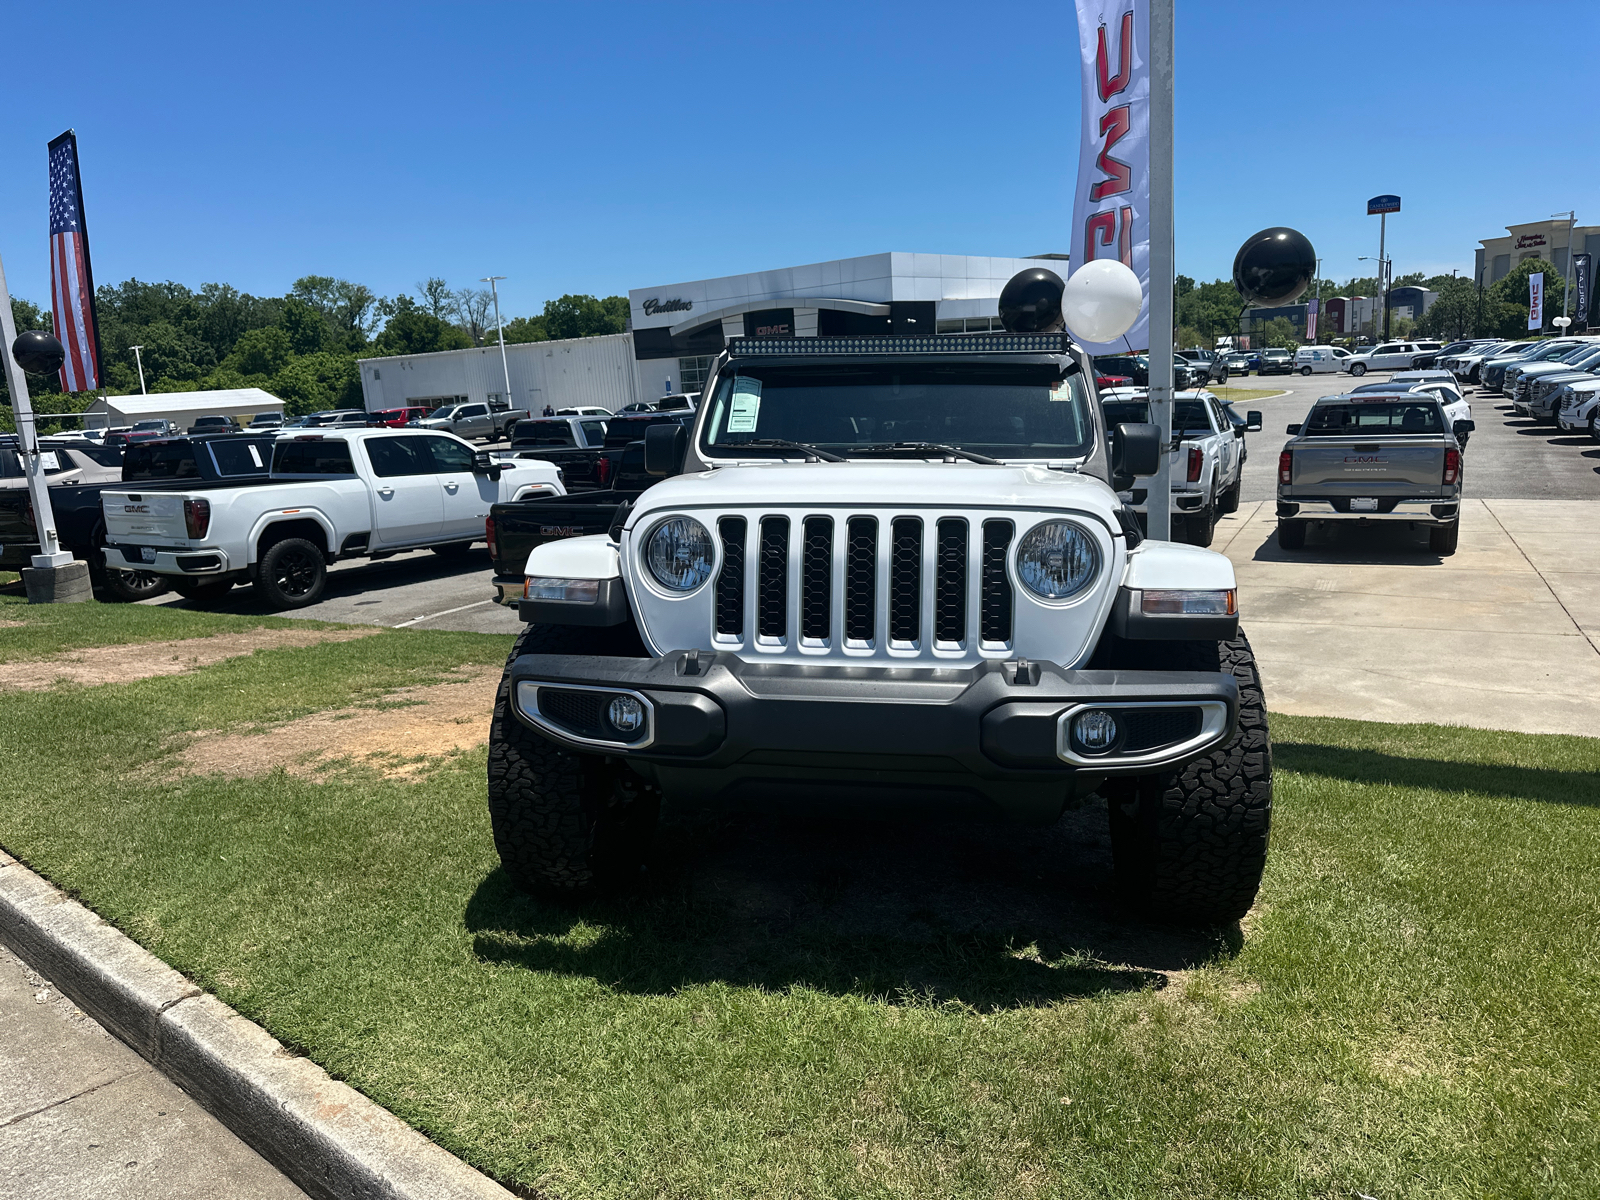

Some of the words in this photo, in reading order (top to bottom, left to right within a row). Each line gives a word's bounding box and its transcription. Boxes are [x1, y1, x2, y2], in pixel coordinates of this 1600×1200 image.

[1531, 284, 1539, 320] GMC
[643, 299, 692, 317] Cadillac
[756, 324, 789, 336] GMC
[1344, 456, 1389, 464] GMC
[124, 505, 150, 514] GMC
[540, 525, 584, 536] GMC
